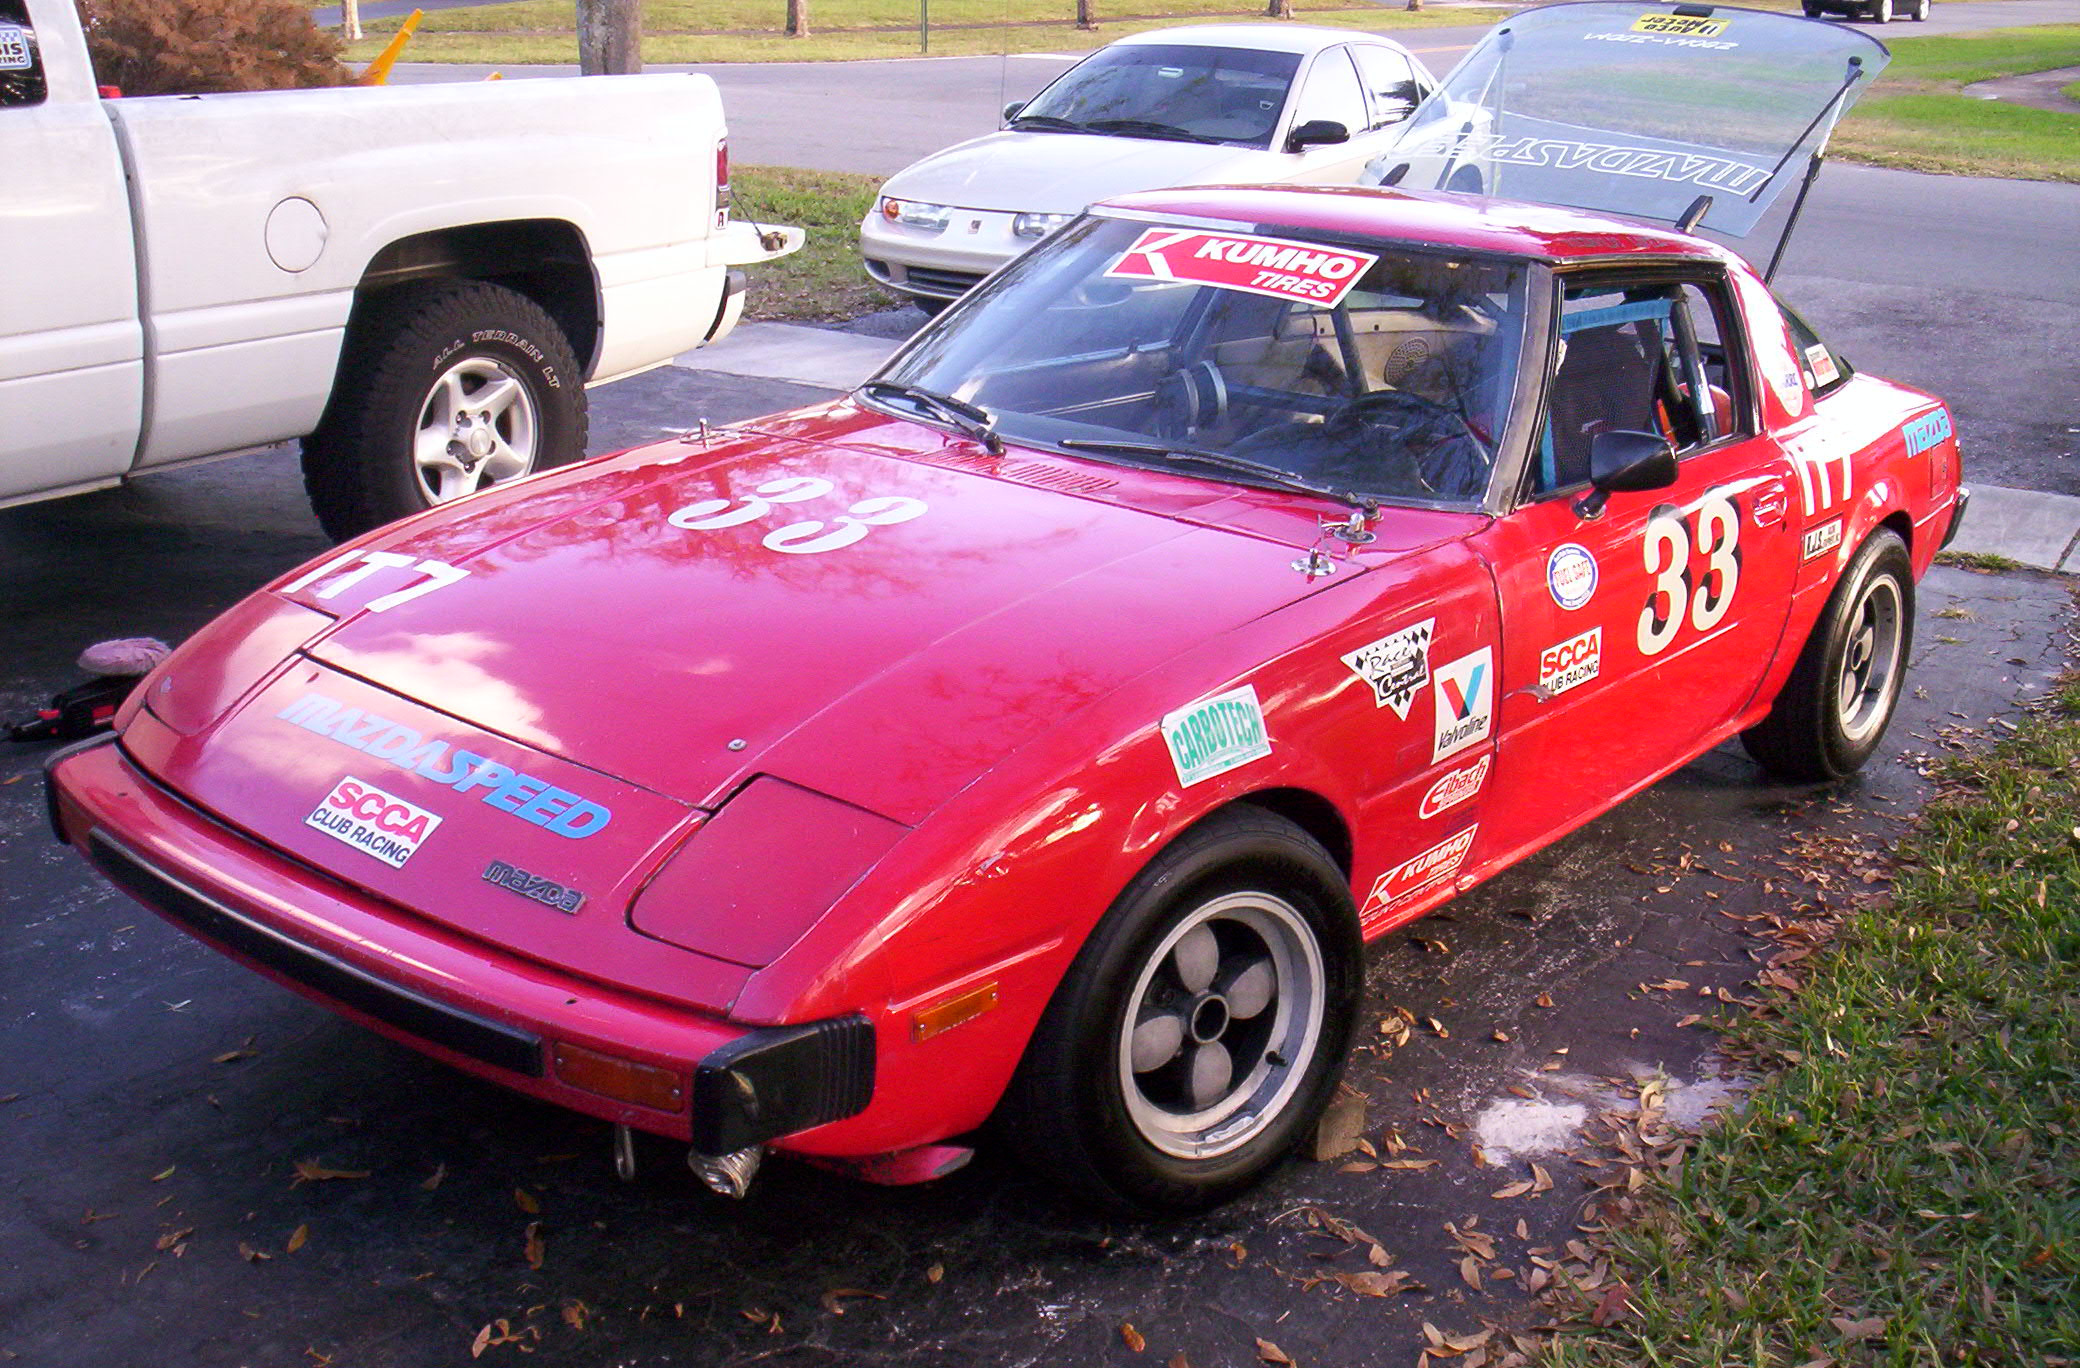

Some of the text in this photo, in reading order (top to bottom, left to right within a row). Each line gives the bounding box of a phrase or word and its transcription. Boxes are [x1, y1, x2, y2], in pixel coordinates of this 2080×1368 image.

[1194, 239, 1357, 280] KUMHO
[1250, 271, 1337, 299] TIRES
[433, 329, 560, 389] ALL TERRAIN LT
[667, 476, 930, 555] 33
[280, 549, 472, 614] IT7
[1637, 486, 1743, 656] 33
[1542, 633, 1599, 679] SCCA
[1565, 659, 1599, 686] RACING
[1172, 701, 1260, 770] CARBOTECH
[1438, 714, 1489, 751] Valvoline
[274, 692, 612, 840] MAZDASPEED
[311, 806, 410, 864] CLUB RACING
[328, 782, 430, 845] SCCA
[1402, 833, 1471, 882] KUMHO
